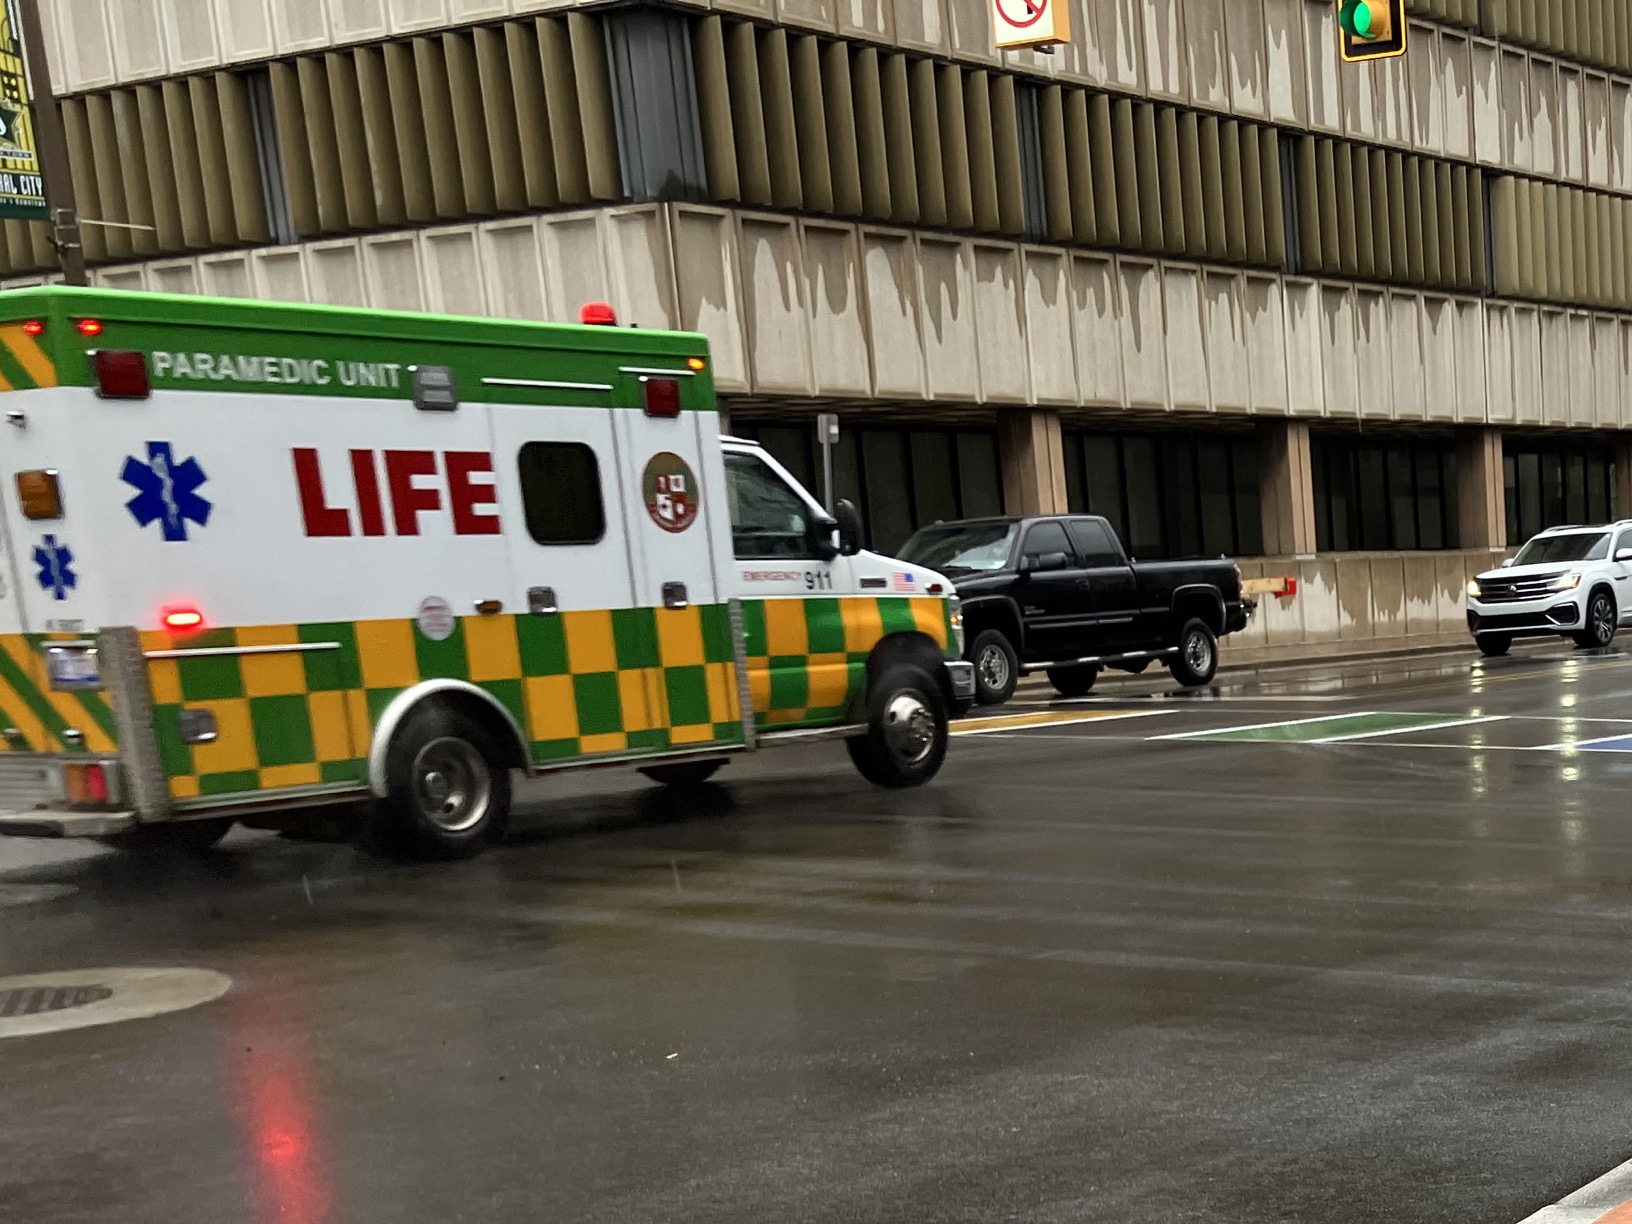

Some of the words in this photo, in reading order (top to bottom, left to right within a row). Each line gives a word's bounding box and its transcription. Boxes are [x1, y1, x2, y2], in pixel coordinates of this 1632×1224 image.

[20, 175, 43, 197] CITY
[151, 350, 332, 386] PARAMEDIC
[334, 360, 402, 388] UNIT
[292, 446, 504, 538] LIFE
[804, 570, 833, 590] 911
